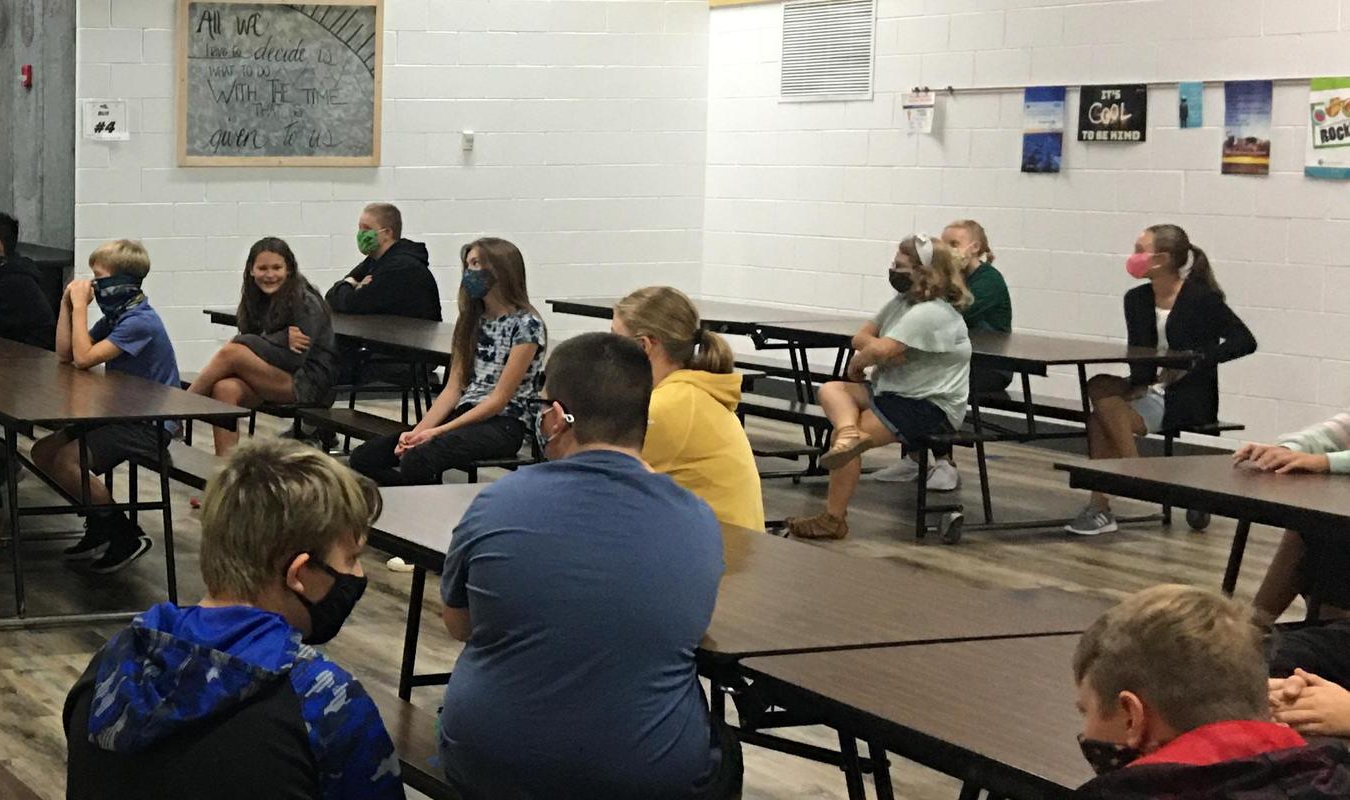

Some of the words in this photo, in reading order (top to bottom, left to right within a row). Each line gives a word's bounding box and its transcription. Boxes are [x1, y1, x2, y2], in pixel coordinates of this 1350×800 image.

[196, 9, 221, 40] All
[254, 36, 306, 62] decide
[207, 79, 257, 104] WITH
[266, 78, 293, 103] THE
[301, 87, 347, 105] TIME
[1101, 89, 1122, 100] IT'S
[94, 121, 116, 133] #4
[209, 117, 268, 153] given
[308, 128, 343, 148] us
[1082, 130, 1095, 140] TO
[1096, 130, 1109, 140] BE
[1111, 130, 1141, 140] KIND
